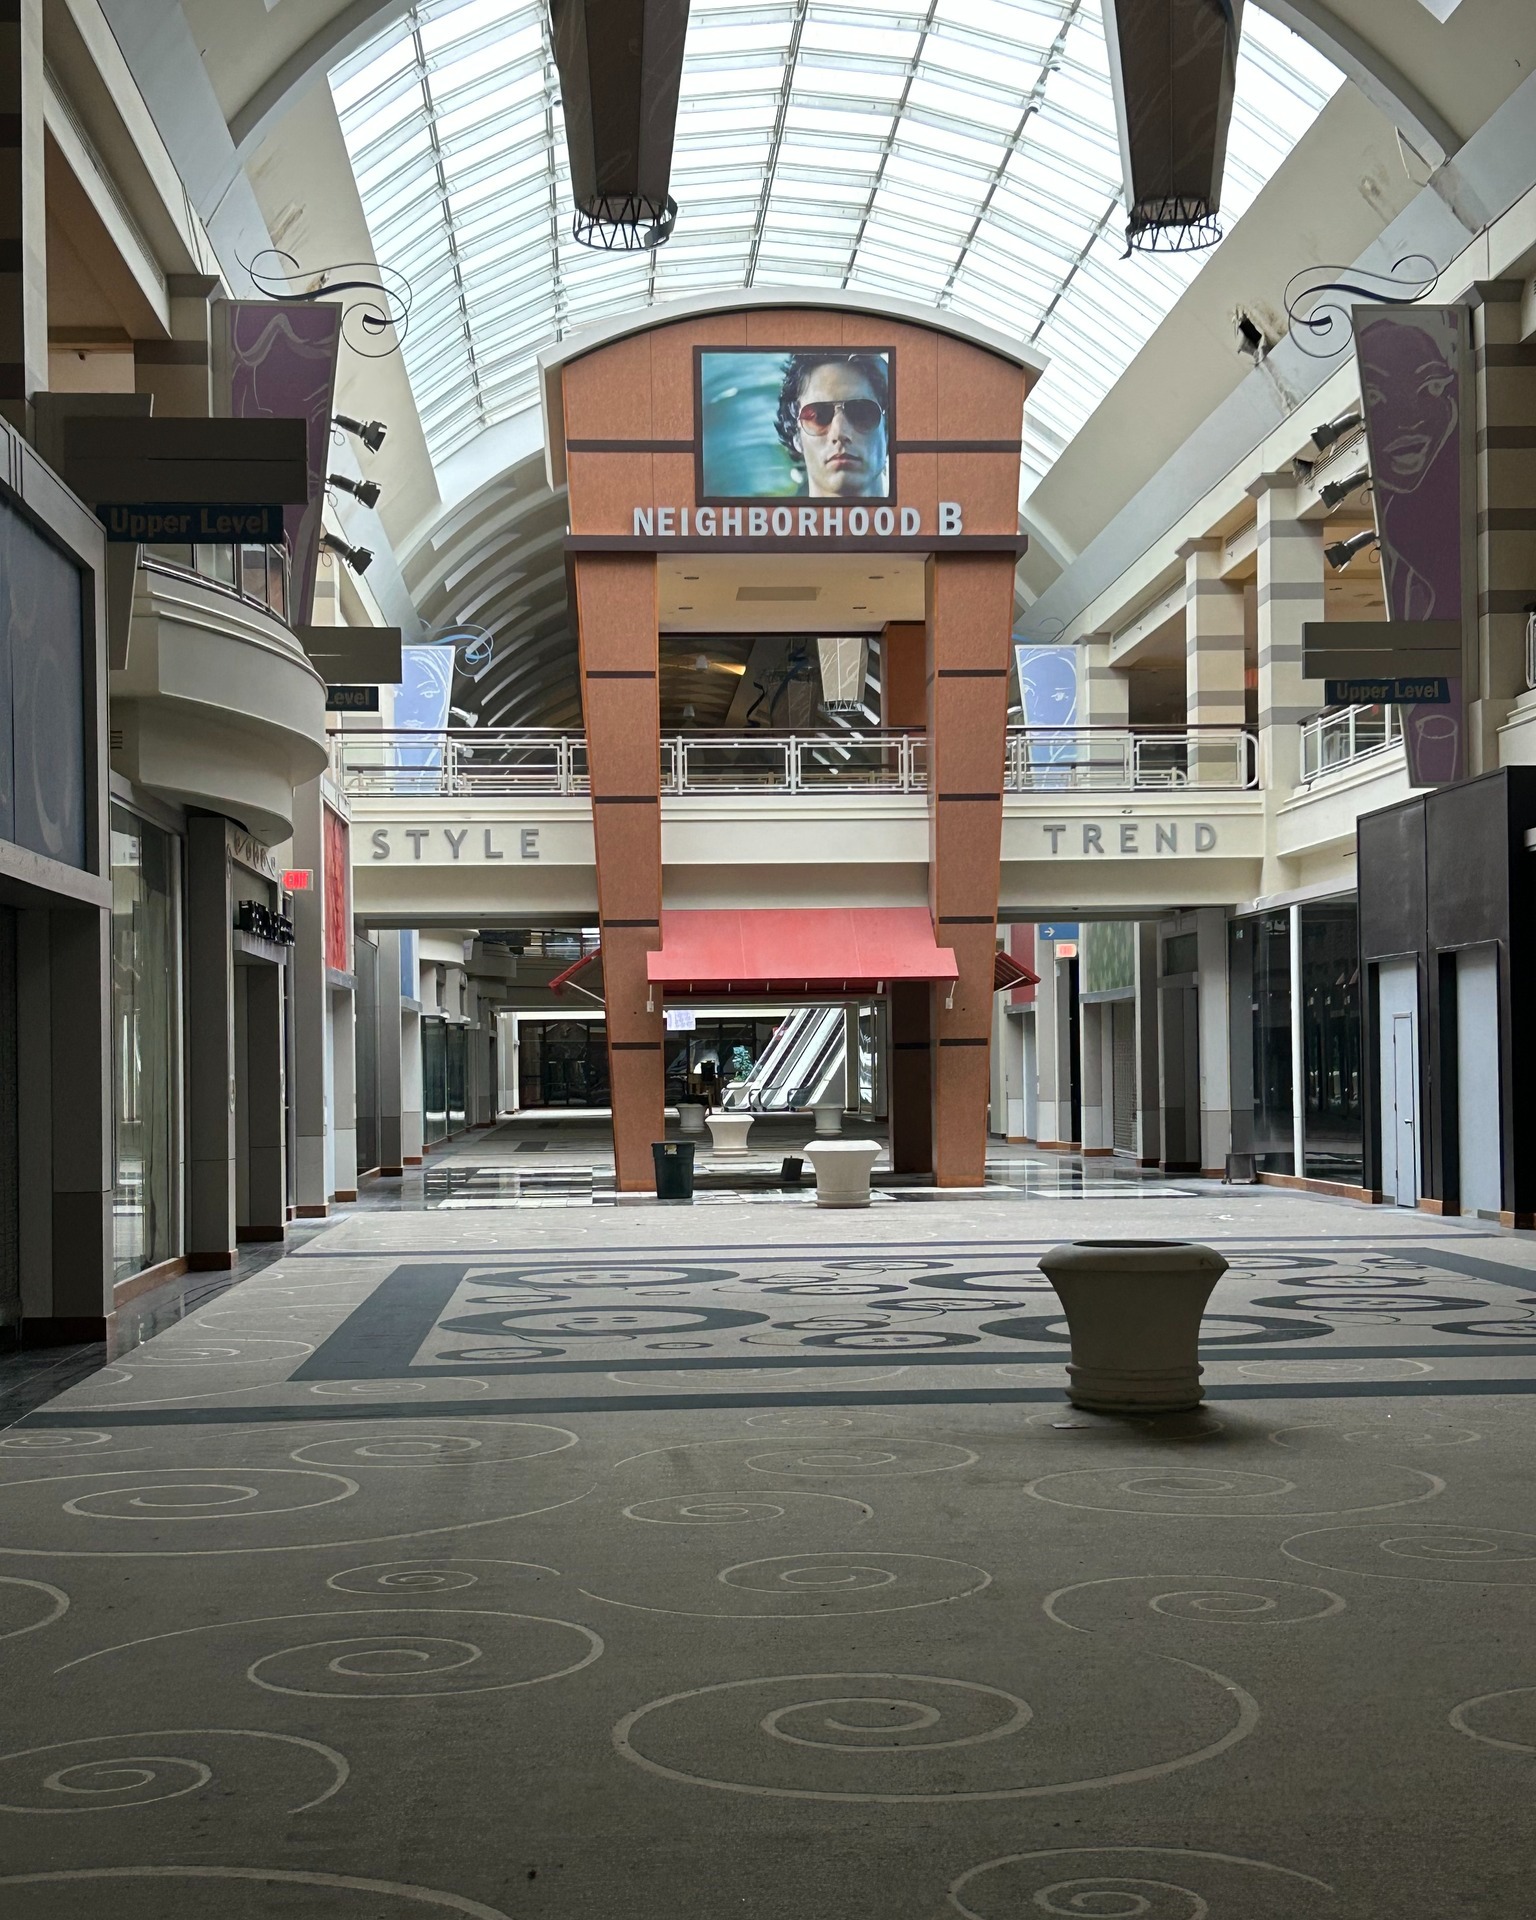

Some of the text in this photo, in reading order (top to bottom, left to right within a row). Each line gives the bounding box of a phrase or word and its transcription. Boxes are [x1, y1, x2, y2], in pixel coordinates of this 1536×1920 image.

[110, 507, 269, 538] Upper Level
[633, 502, 963, 536] NEIGHBORHOOD B
[1336, 680, 1439, 702] Upper Level
[371, 828, 540, 859] STYLE
[1042, 822, 1217, 854] TREND
